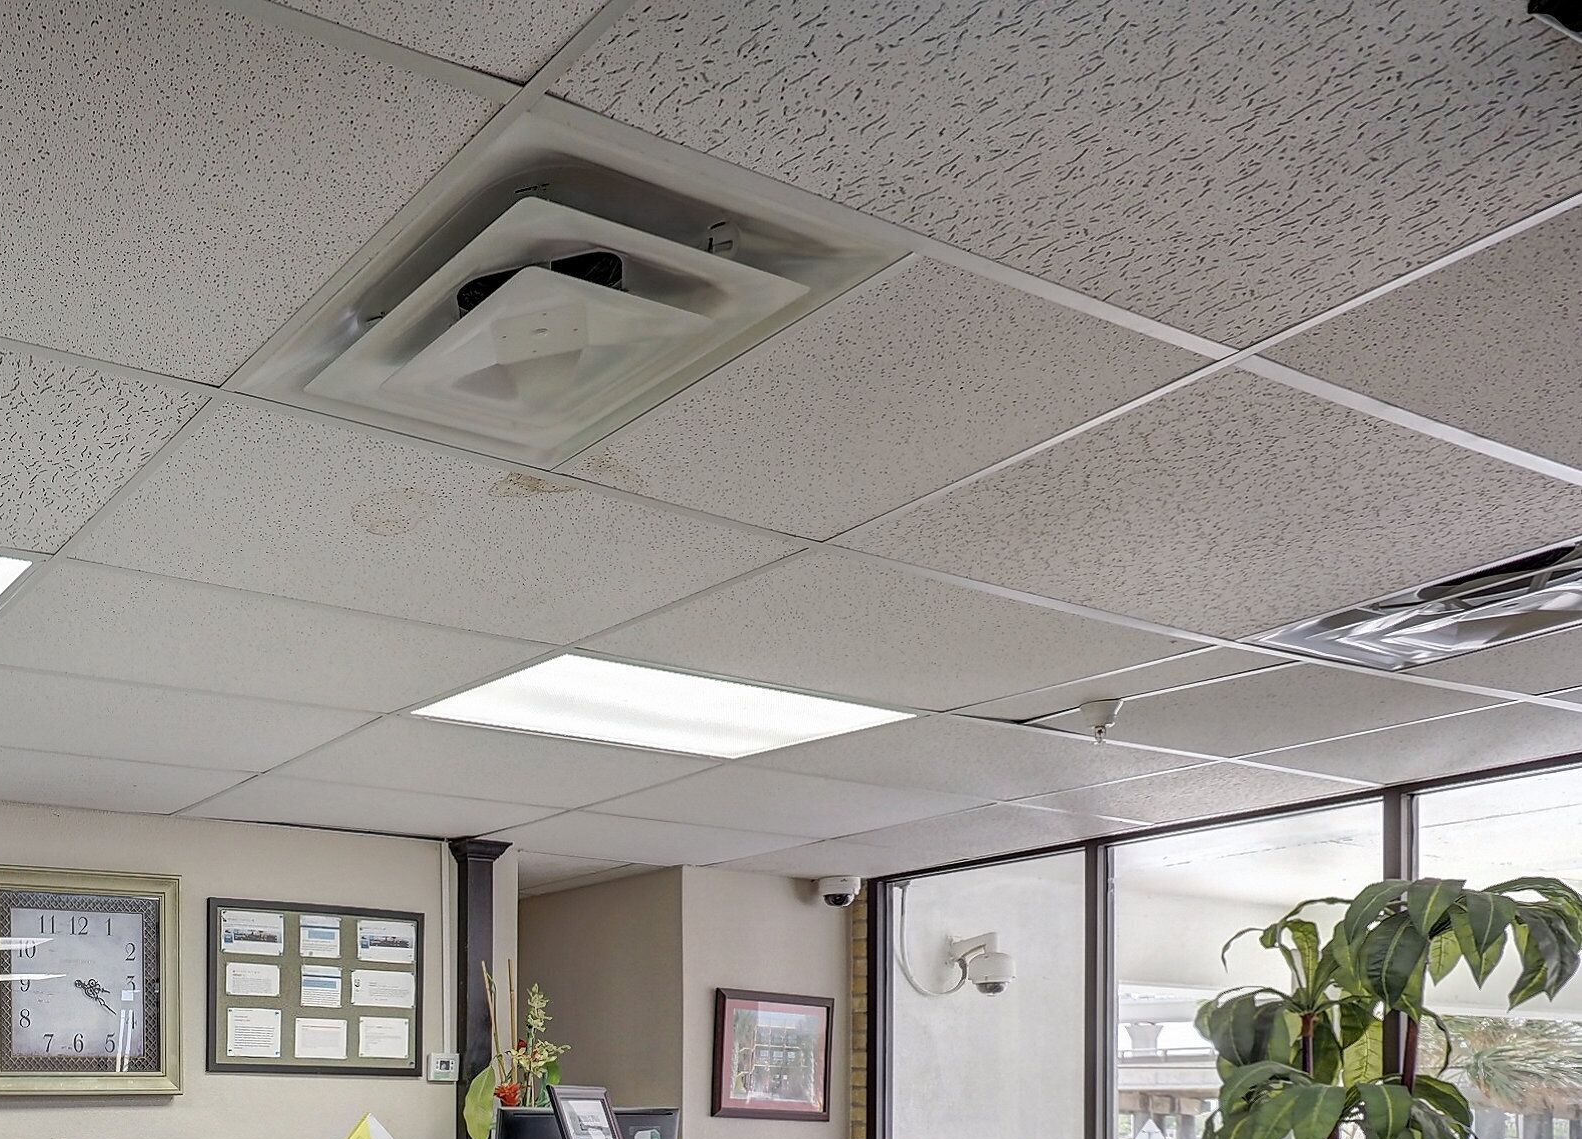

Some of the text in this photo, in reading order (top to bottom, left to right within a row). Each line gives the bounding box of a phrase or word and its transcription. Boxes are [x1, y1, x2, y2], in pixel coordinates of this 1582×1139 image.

[39, 915, 113, 937] 11 12 1
[124, 943, 136, 961] 2
[125, 975, 136, 991] 3
[19, 1008, 31, 1029] 8
[43, 1032, 116, 1053] 7 6 5
